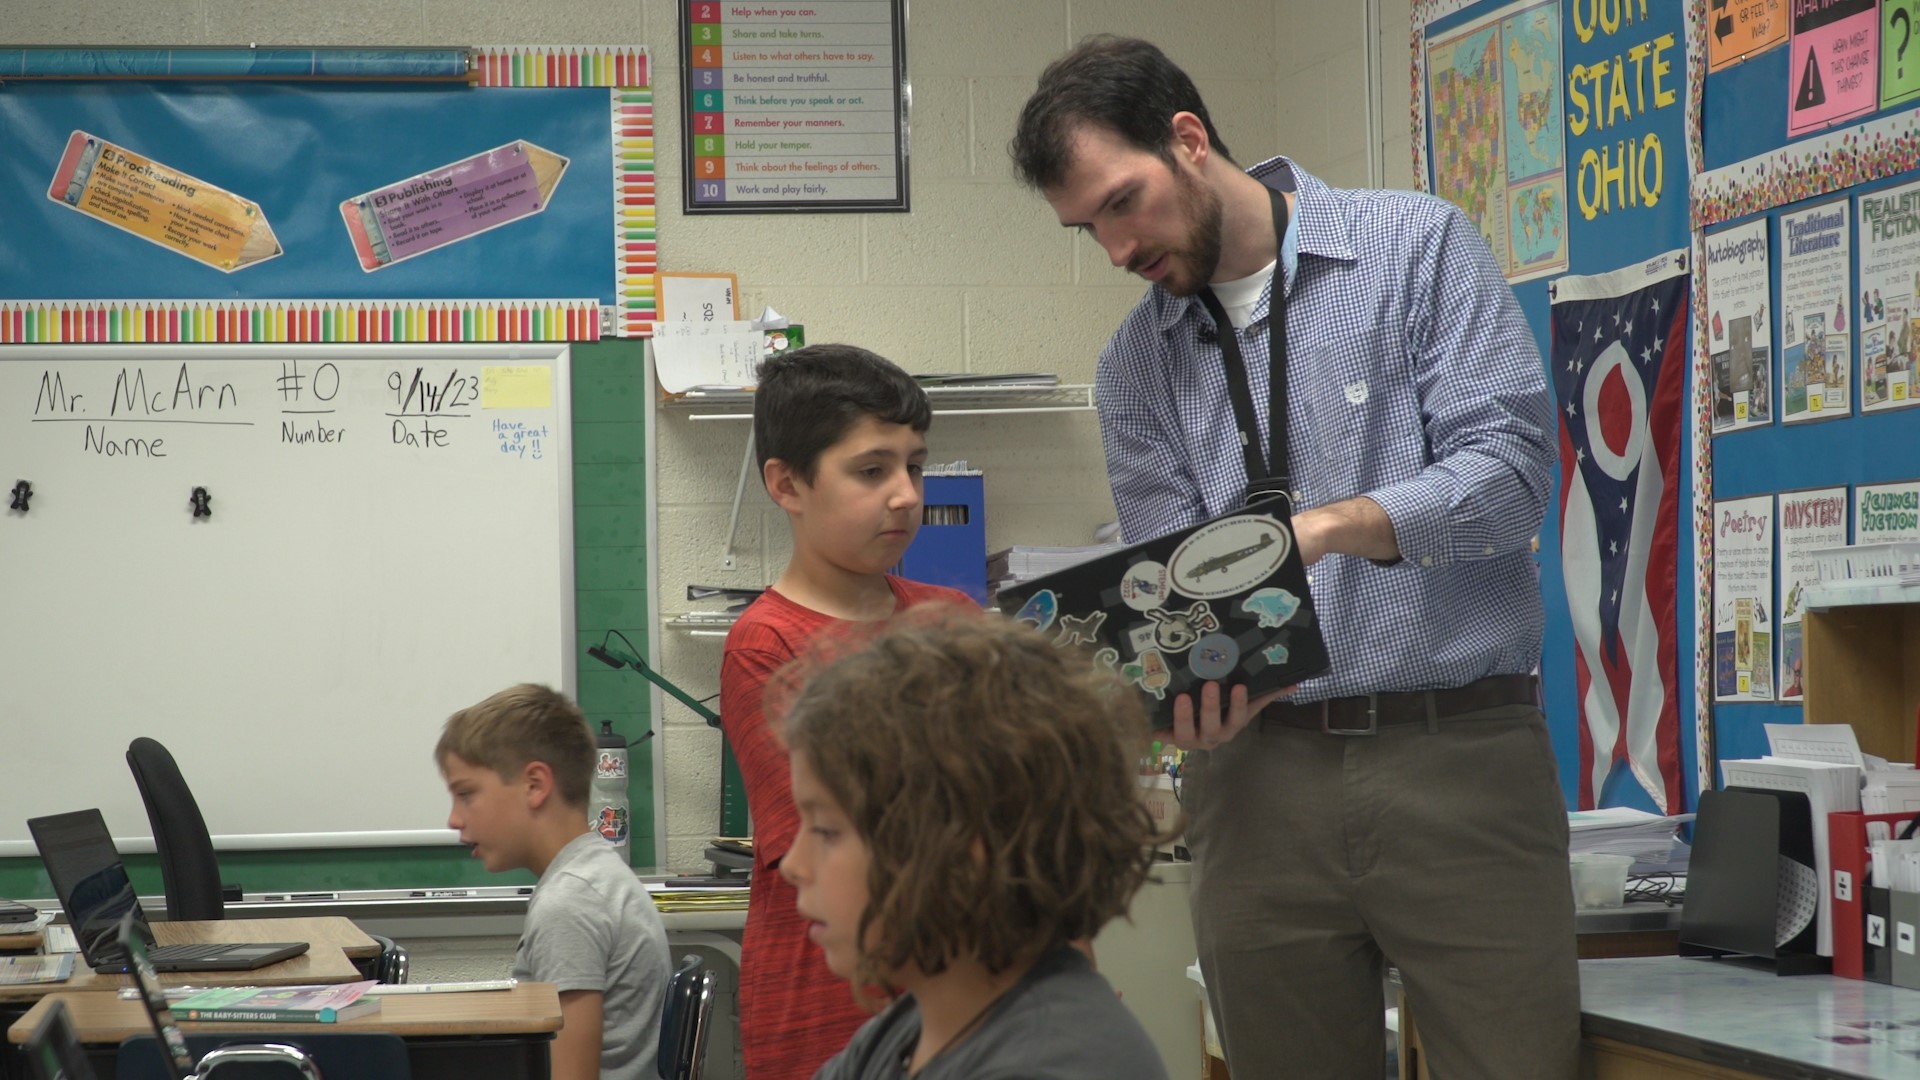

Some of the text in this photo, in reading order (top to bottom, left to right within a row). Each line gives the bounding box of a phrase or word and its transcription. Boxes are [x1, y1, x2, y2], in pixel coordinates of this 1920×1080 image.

[702, 6, 710, 18] 2
[732, 8, 751, 17] Help
[754, 8, 777, 17] when
[781, 9, 796, 18] you
[702, 28, 711, 40] 3
[733, 30, 757, 38] Share
[760, 30, 776, 38] and
[779, 30, 798, 38] take
[702, 50, 711, 62] 4
[733, 52, 757, 60] Listen
[770, 52, 791, 60] what
[794, 52, 820, 60] others
[858, 53, 874, 62] say.
[703, 72, 712, 84] 5
[747, 74, 775, 83] honest
[778, 74, 794, 82] and
[796, 74, 829, 83] truthful.
[1569, 32, 1675, 136] STATE
[704, 94, 712, 107] 6
[734, 96, 756, 104] Think
[759, 96, 786, 104] before
[790, 98, 805, 107] you
[809, 96, 834, 106] speak
[705, 116, 713, 129] 7
[735, 119, 779, 127] Remember
[783, 120, 802, 129] your
[705, 138, 713, 151] 8
[736, 141, 755, 149] Hold
[758, 143, 778, 151] your
[99, 162, 120, 175] Make
[128, 175, 155, 190] Correct
[116, 155, 197, 198] Proofreading
[706, 161, 880, 174] 9 Think about the feelings of others.
[1577, 133, 1663, 221] OHIO
[95, 187, 111, 197] Check
[388, 174, 452, 203] Publishing
[412, 196, 430, 205] With
[433, 186, 458, 199] Others
[703, 184, 827, 197] 10 Work and play fairly.
[89, 200, 100, 208] and
[101, 205, 116, 215] word
[174, 212, 188, 222] Have
[214, 230, 230, 240] check
[1786, 206, 1844, 238] Traditional
[1708, 231, 1765, 265] Autobiography
[1789, 232, 1840, 257] Literature
[35, 362, 236, 416] Mr. McArn
[388, 368, 478, 413] 9/14/23
[282, 420, 345, 443] Number
[393, 420, 449, 448] Date
[493, 419, 524, 432] Have
[514, 426, 548, 443] great
[85, 425, 166, 456] Name
[500, 443, 526, 458] day
[1862, 490, 1919, 511] SCIENCE
[1784, 497, 1844, 530] MYSTERY
[1862, 512, 1918, 532] FICTION
[1721, 510, 1767, 541] Poetry
